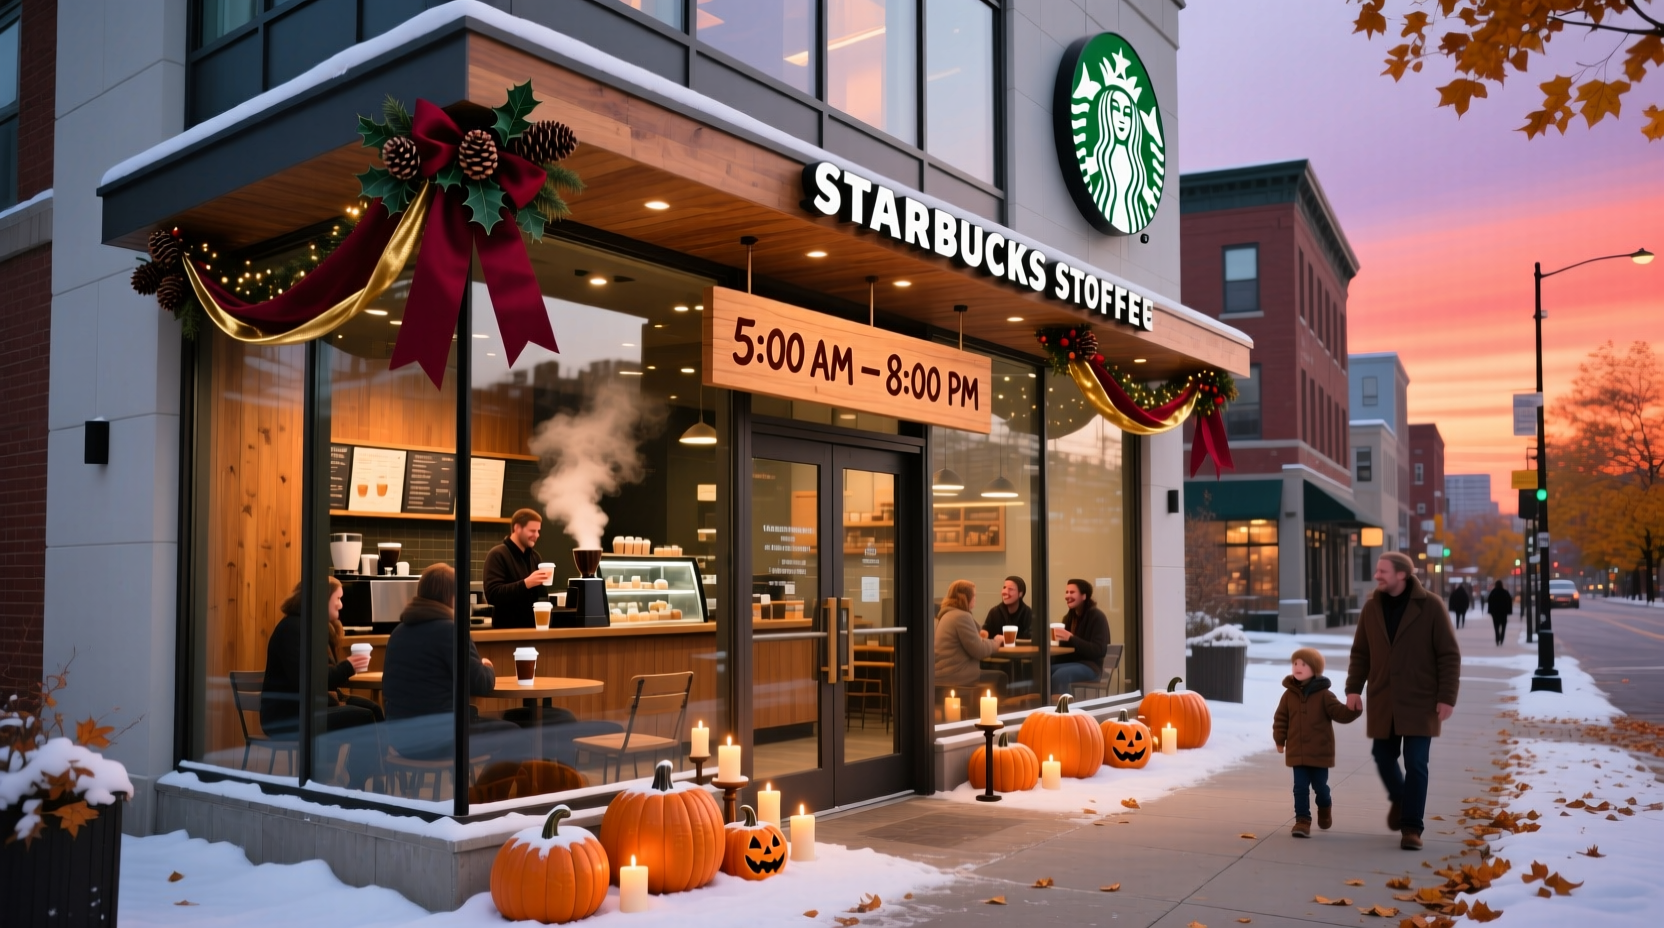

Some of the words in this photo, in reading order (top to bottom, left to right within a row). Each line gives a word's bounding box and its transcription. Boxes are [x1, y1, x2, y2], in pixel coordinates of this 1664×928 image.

[813, 162, 1047, 292] STARBUCKS
[732, 316, 805, 373] 5:00
[810, 339, 854, 386] AM
[885, 353, 941, 403] 8:00
[948, 370, 979, 411] PM
